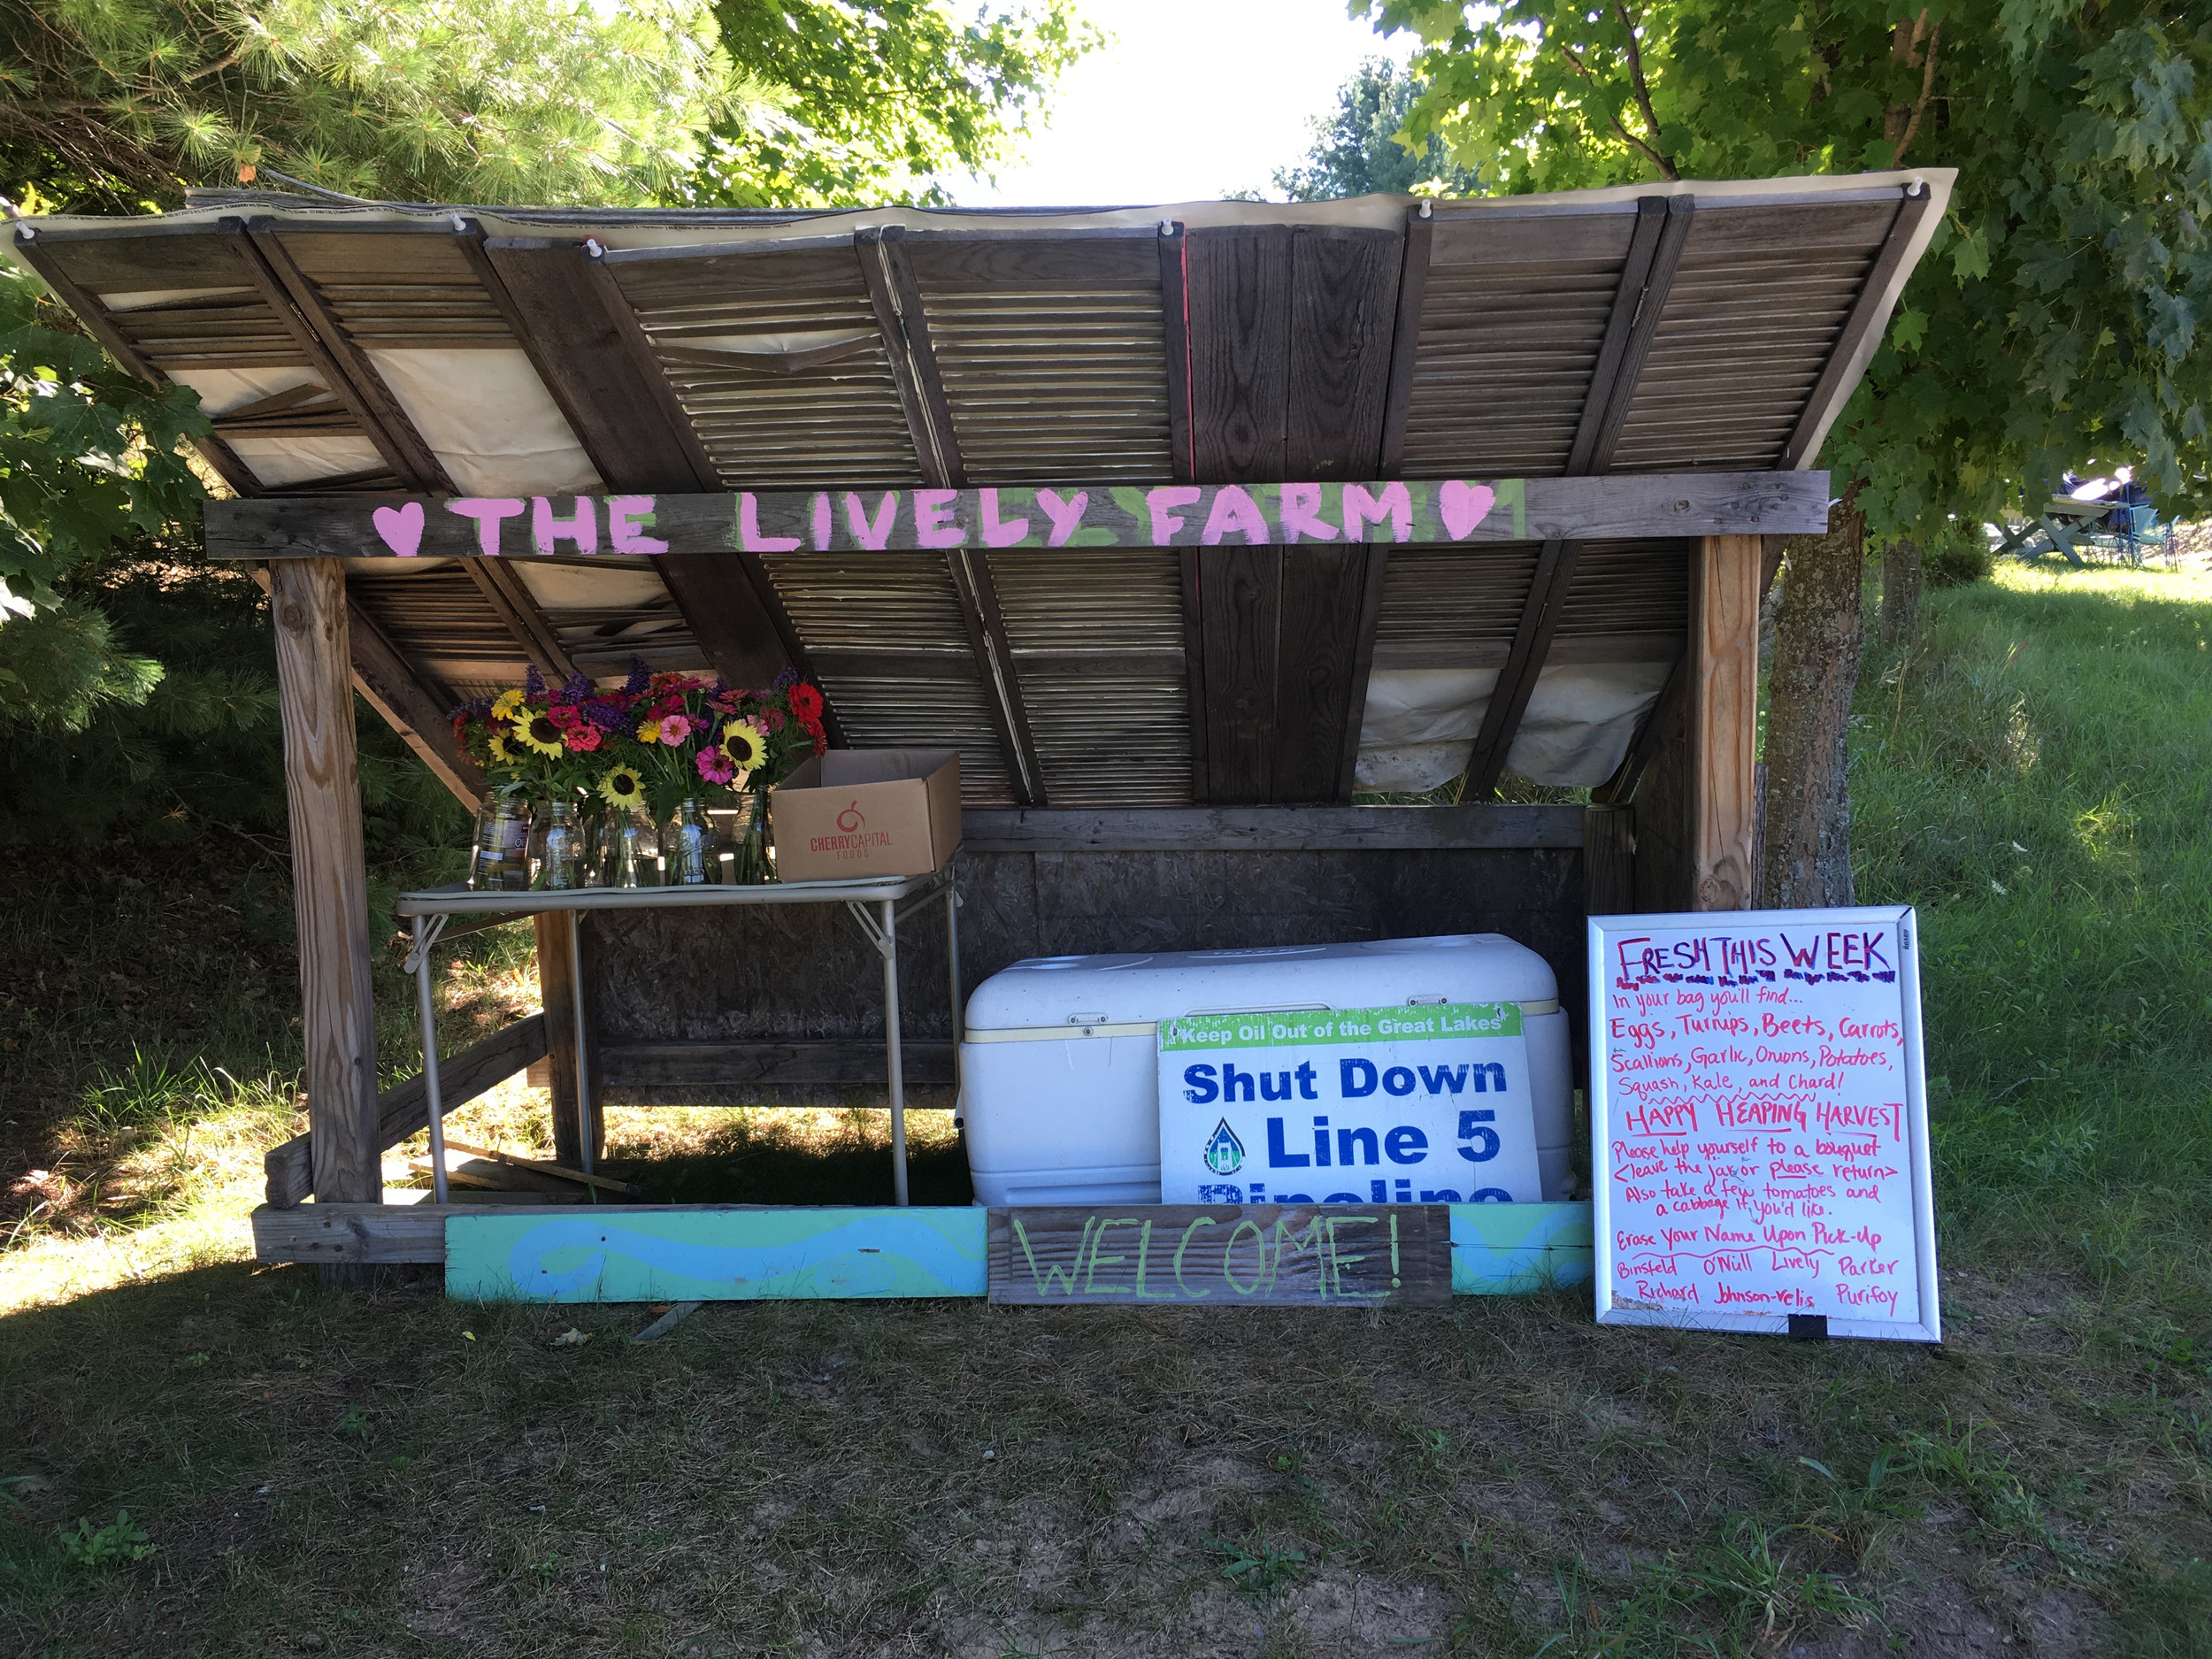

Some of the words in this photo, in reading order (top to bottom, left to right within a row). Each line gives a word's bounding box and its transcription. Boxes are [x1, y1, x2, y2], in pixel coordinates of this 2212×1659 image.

[444, 495, 669, 555] THE
[733, 488, 1089, 553] LIVELY
[1145, 481, 1413, 546] FARM
[837, 849, 870, 861] FOODS
[1617, 937, 1711, 981] FRESH
[1709, 936, 1777, 978] THIS
[1779, 932, 1892, 971] WEEK
[1612, 994, 1631, 1009] In
[1636, 993, 1670, 1018] your
[1677, 988, 1704, 1013] bag
[1710, 987, 1749, 1017] you'll
[1182, 1027, 1233, 1045] Keep
[1239, 1025, 1265, 1041] Oil
[1272, 1023, 1307, 1040] Out
[1313, 1021, 1333, 1037] of
[1340, 1020, 1371, 1037] the
[1378, 1018, 1434, 1034] Great
[1440, 1016, 1502, 1032] Lakes
[1609, 1018, 1676, 1049] Eggs,
[1675, 1011, 1759, 1038] Turnips,
[1762, 1012, 1834, 1042] Beets,
[1839, 1017, 1904, 1047] Carrots,
[1610, 1051, 1692, 1075] Scallions,
[1691, 1044, 1754, 1070] Garlic,
[1755, 1045, 1816, 1070] Onions,
[1819, 1044, 1893, 1071] Potatoes,
[1183, 1060, 1318, 1104] Shut
[1340, 1057, 1508, 1098] Down
[1618, 1076, 1687, 1102] Squash,
[1748, 1072, 1780, 1088] and
[1788, 1071, 1844, 1096] Chard!
[1625, 1102, 1699, 1134] HAPPY
[1715, 1101, 1807, 1133] HEAPING
[1816, 1101, 1904, 1142] HARVEST
[1266, 1115, 1429, 1169] Line
[1456, 1109, 1501, 1163] 5
[1611, 1140, 1659, 1164] Please
[1659, 1138, 1689, 1160] help
[1697, 1136, 1759, 1161] yourself
[1767, 1137, 1786, 1155] to
[1793, 1144, 1810, 1157] a
[1816, 1138, 1881, 1162] bouquet
[1674, 1157, 1703, 1175] the
[1708, 1164, 1733, 1188] jar
[1740, 1165, 1760, 1176] or
[1770, 1158, 1824, 1181] please
[1625, 1186, 1656, 1204] Also
[1660, 1179, 1697, 1200] take
[1703, 1180, 1718, 1197] a
[1721, 1179, 1755, 1198] few
[1763, 1182, 1837, 1200] tomatoes
[1846, 1184, 1881, 1203] and
[1655, 1203, 1669, 1217] a
[1672, 1196, 1730, 1220] cabbage
[1735, 1198, 1748, 1210] if
[1752, 1199, 1794, 1225] you'd
[1801, 1199, 1832, 1218] like.
[1617, 1230, 1656, 1251] Erase
[1660, 1227, 1698, 1251] Your
[1704, 1223, 1756, 1243] Name
[1763, 1224, 1806, 1248] Upon
[1811, 1221, 1882, 1252] Pick-Up
[1013, 1213, 1402, 1301] WELCOME!
[1617, 1256, 1678, 1279] Binsfeld
[1771, 1251, 1820, 1279] Lively
[1838, 1256, 1899, 1276] Parker
[1636, 1280, 1700, 1304] Richard
[1835, 1283, 1899, 1317] Purifoy
